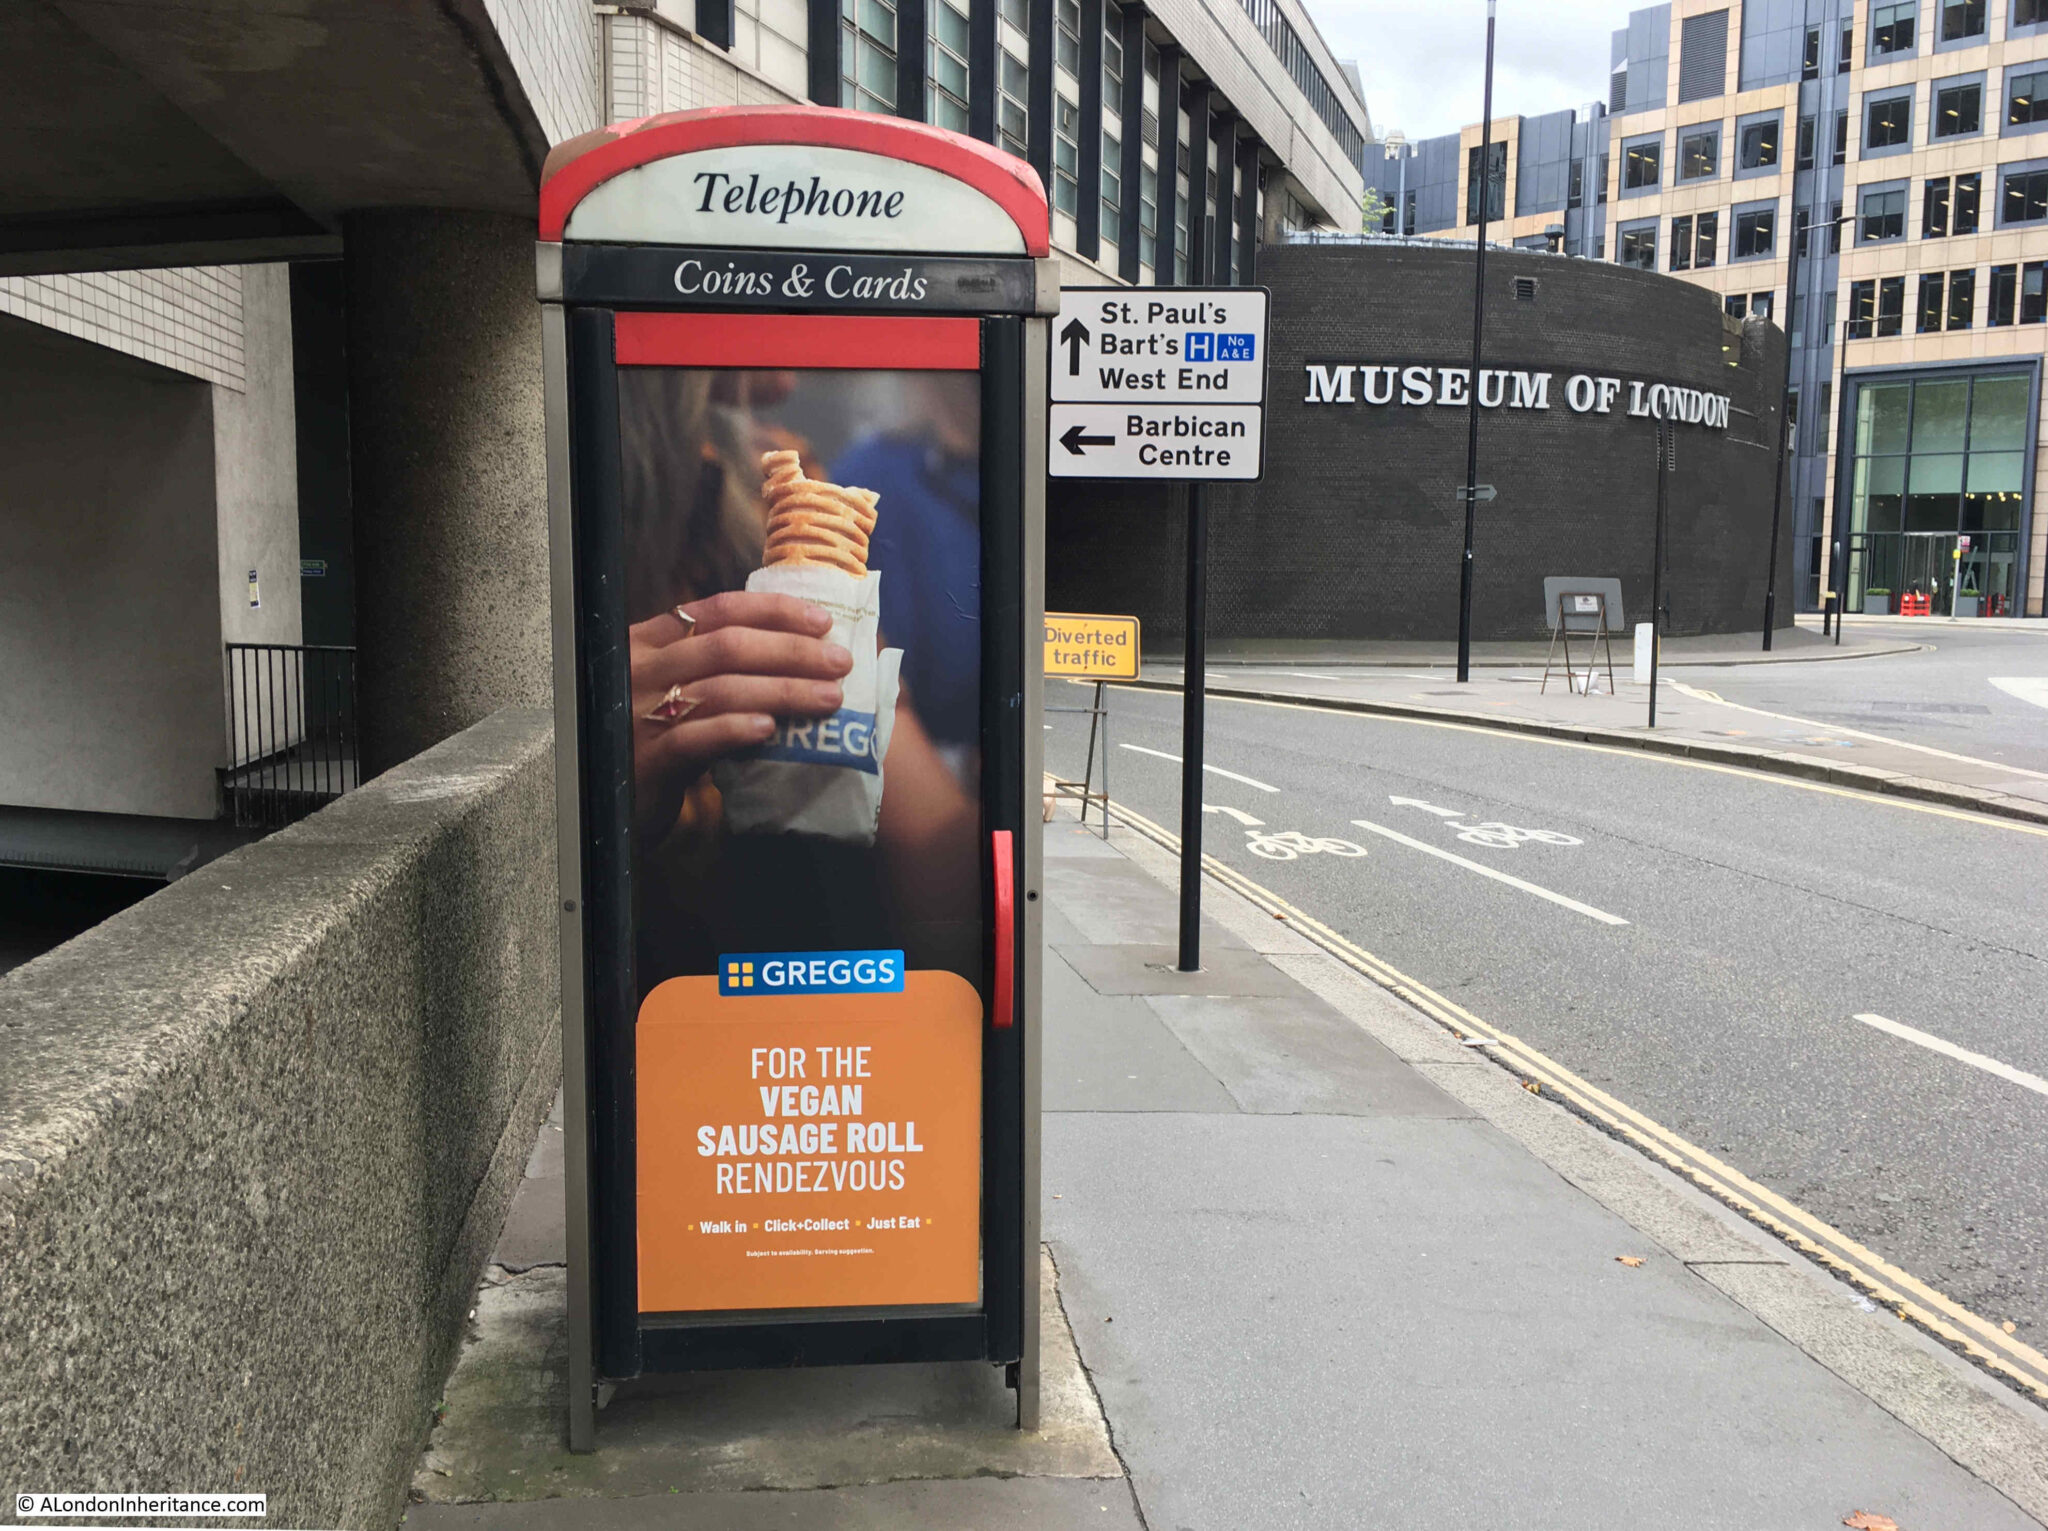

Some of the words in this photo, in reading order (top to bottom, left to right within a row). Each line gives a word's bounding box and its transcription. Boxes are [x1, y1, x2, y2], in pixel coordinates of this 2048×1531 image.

[693, 172, 905, 225] Telephone
[674, 259, 774, 296] Coins
[782, 263, 814, 297] &
[824, 264, 928, 301] Cards
[1100, 301, 1139, 325] St.
[1148, 302, 1227, 325] Paul's
[1100, 332, 1179, 356] Bart's
[1190, 335, 1210, 359] H
[1228, 335, 1245, 346] No
[1099, 367, 1166, 390] West
[1178, 368, 1228, 390] End
[1304, 364, 1552, 409] MUSEUM
[1565, 373, 1621, 414] OF
[1626, 380, 1731, 429] LONDON
[1127, 415, 1246, 438] Barbican
[1138, 444, 1231, 467] Centre
[1044, 627, 1127, 646] Diverted
[1053, 648, 1117, 667] traffic
[761, 958, 896, 987] GREGGS
[751, 1048, 807, 1079] FOR
[815, 1046, 872, 1077] THE
[759, 1084, 863, 1118] VEGAN
[697, 1123, 838, 1157] SAUSAGE
[846, 1121, 924, 1153] ROLL
[716, 1159, 906, 1194] RENDEZVOUS
[699, 1221, 732, 1234] Walk
[735, 1220, 747, 1233] in
[764, 1218, 850, 1232] Click+Collect
[866, 1217, 895, 1230] Just
[898, 1216, 921, 1229] Eat
